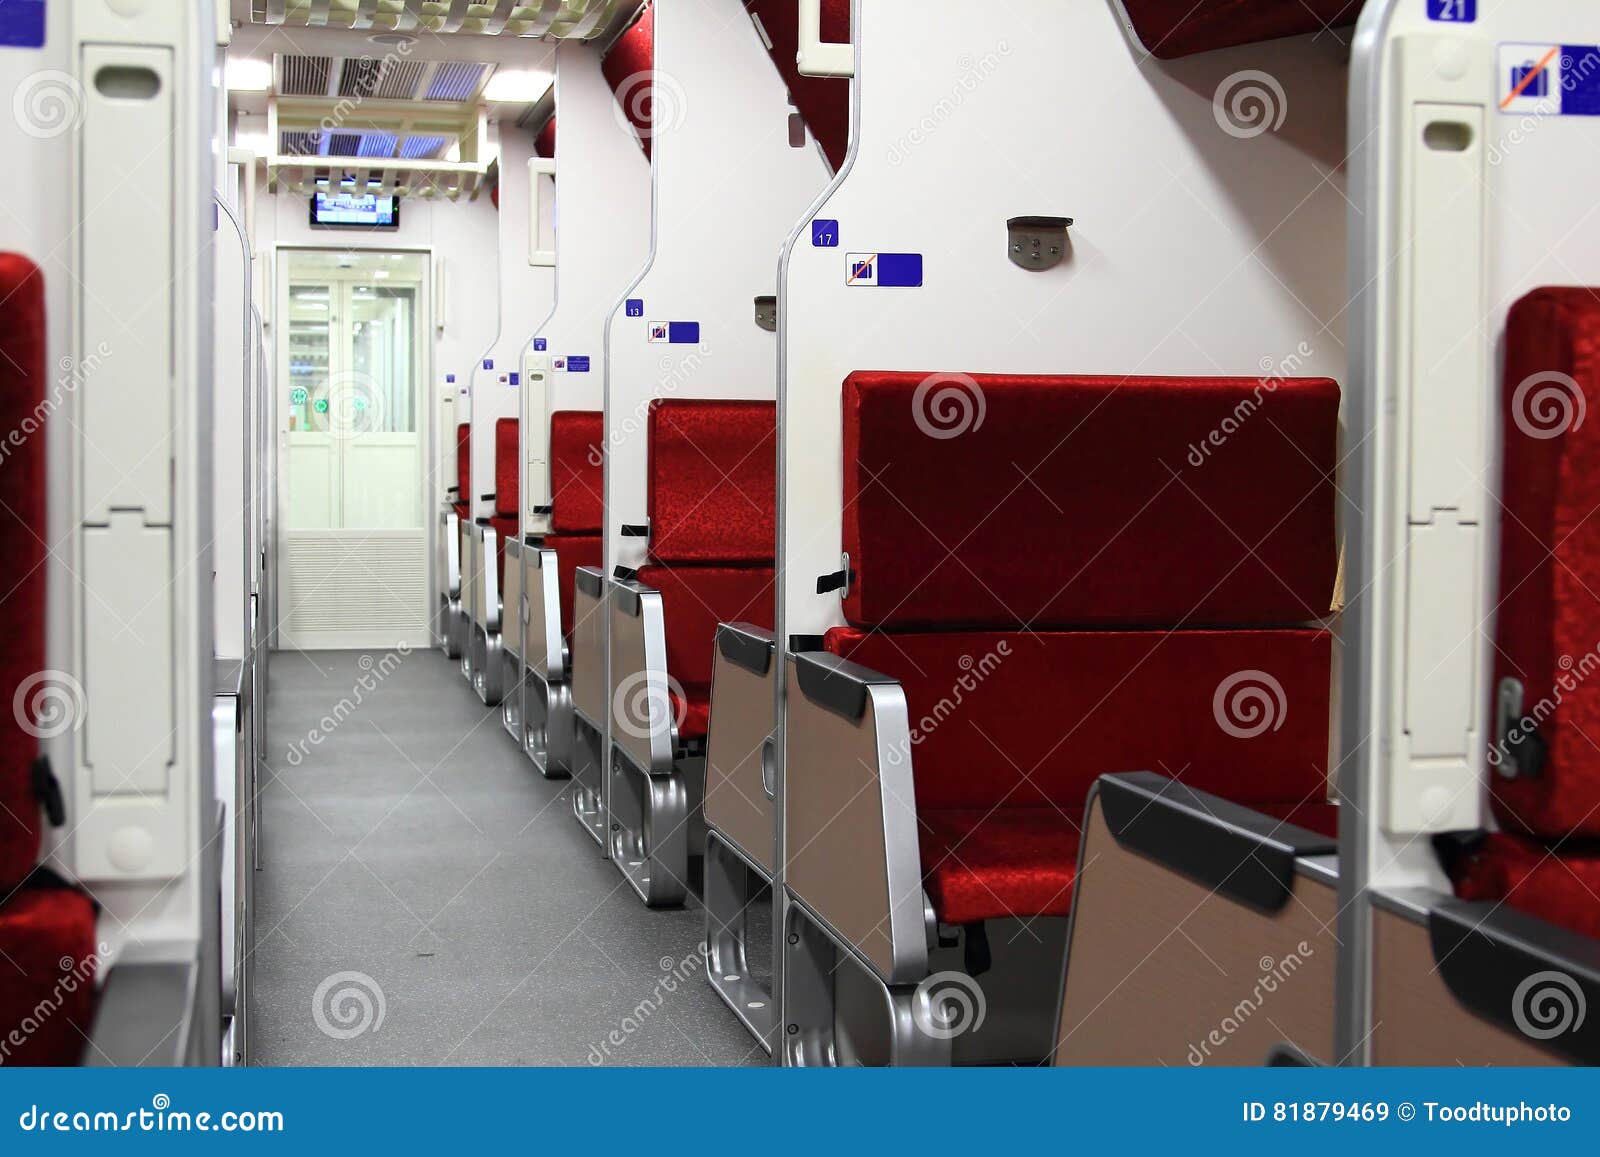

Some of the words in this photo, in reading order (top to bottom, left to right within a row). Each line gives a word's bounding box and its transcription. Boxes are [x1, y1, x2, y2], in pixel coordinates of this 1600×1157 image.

[1438, 0, 1465, 20] 21
[819, 233, 832, 245] 17
[630, 308, 640, 316] 13
